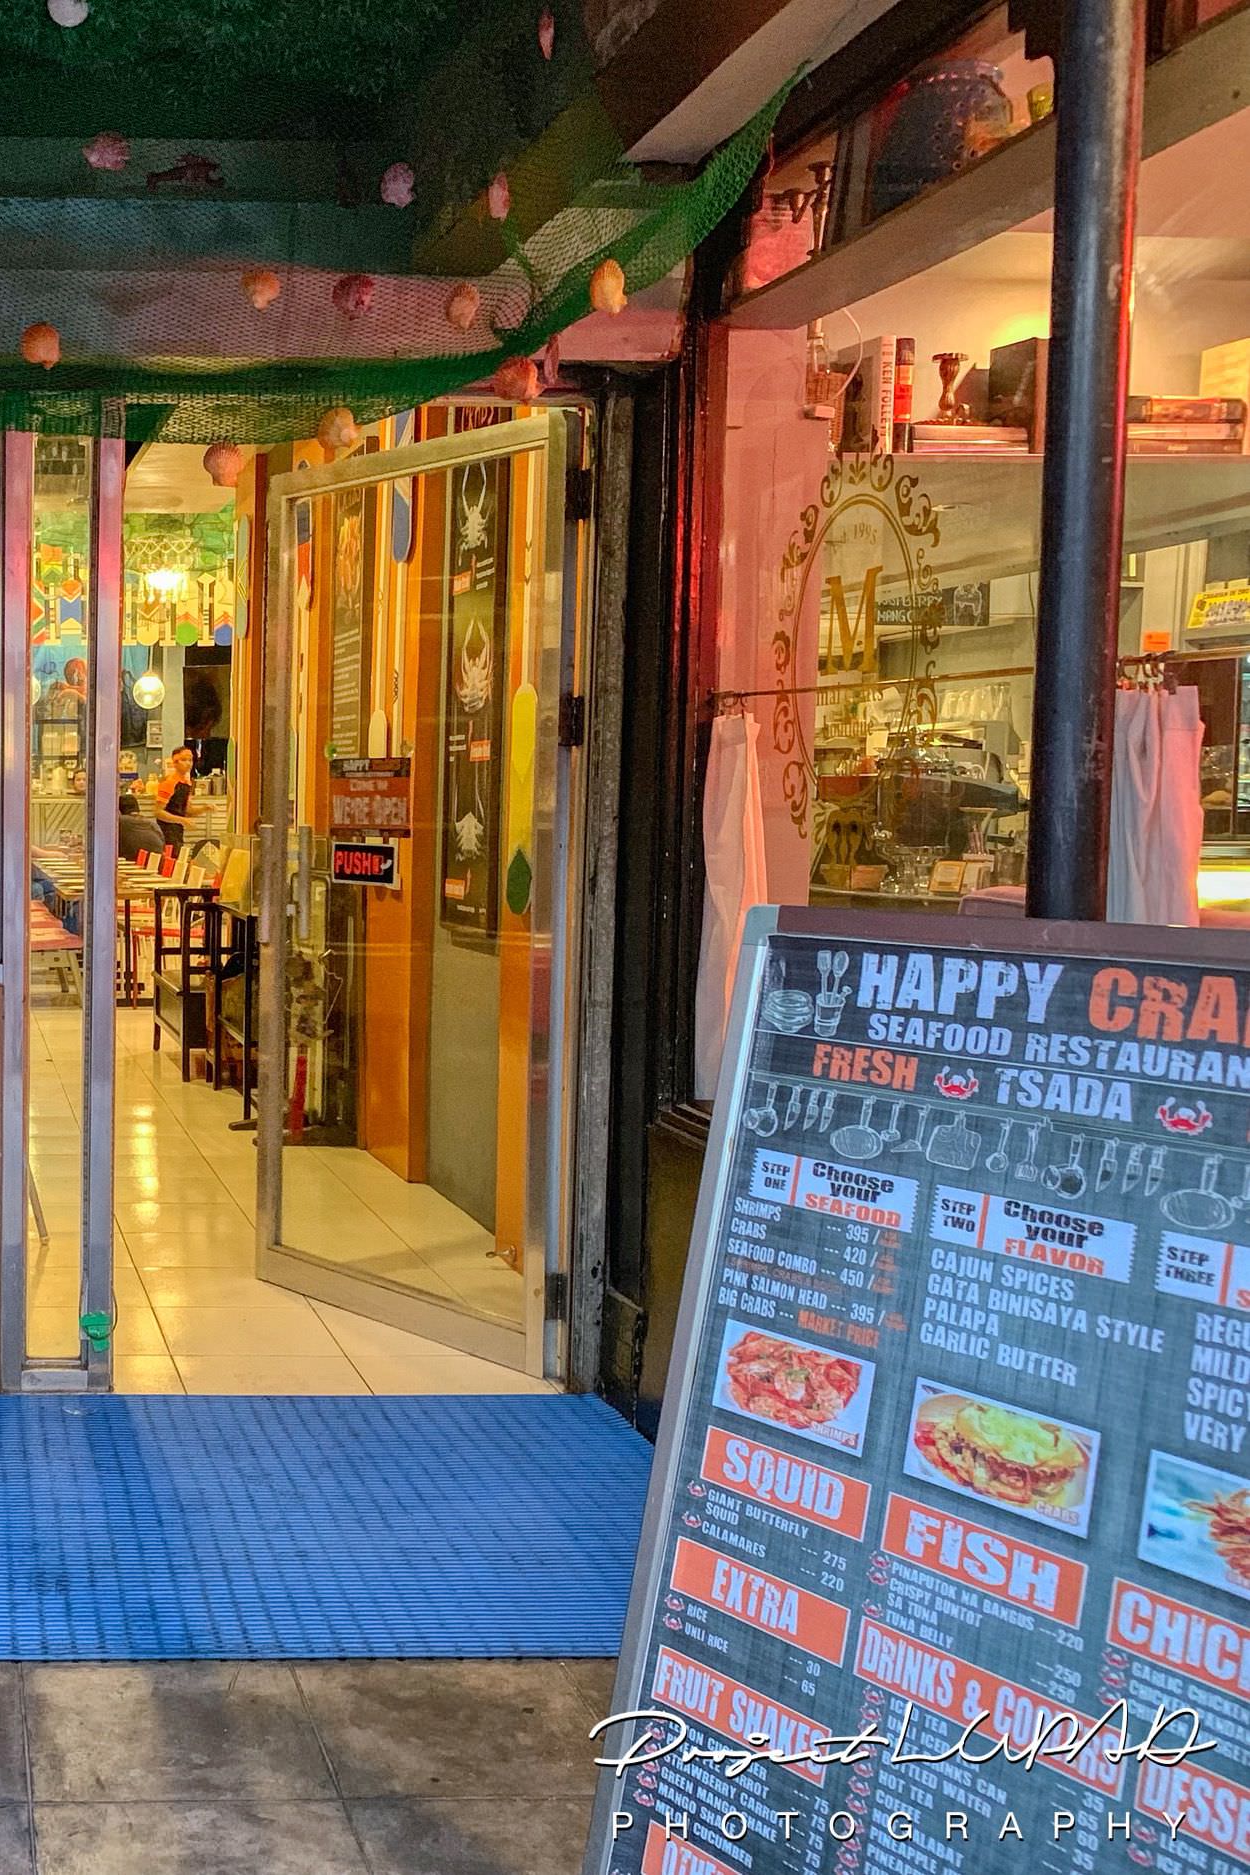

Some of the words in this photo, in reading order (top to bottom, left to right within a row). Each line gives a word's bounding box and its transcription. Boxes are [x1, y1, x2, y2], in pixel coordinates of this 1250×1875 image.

[821, 565, 883, 676] M
[334, 850, 372, 876] PUSH
[857, 952, 1064, 1024] HAPPY
[867, 1012, 1013, 1057] SEAFOOD
[812, 1043, 919, 1092] FRESH
[995, 1067, 1133, 1122] TSADA
[761, 1161, 791, 1177] STEP
[812, 1161, 895, 1194] Choose
[764, 1176, 787, 1191] ONE
[830, 1181, 881, 1203] your
[733, 1196, 782, 1222] SHRIMPS
[845, 1223, 869, 1245] 395
[805, 1193, 901, 1228] SEAFOOD
[940, 1198, 976, 1217] STEP
[1003, 1199, 1105, 1237] Choose
[942, 1214, 976, 1233] TWO
[1025, 1224, 1089, 1249] your
[727, 1237, 775, 1265] SEAFOOD
[776, 1250, 818, 1277] COMBO
[839, 1268, 864, 1288] 450
[730, 1216, 767, 1240] CRABS
[843, 1246, 867, 1266] 420
[1004, 1237, 1106, 1276] FLAVOR
[1166, 1246, 1210, 1268] STEP
[723, 1267, 748, 1289] PINK
[750, 1275, 796, 1304] SALMON
[797, 1289, 828, 1310] HEAD
[850, 1302, 875, 1324] 395
[930, 1248, 994, 1283] CAJUN
[1000, 1264, 1075, 1302] SPICES
[1164, 1263, 1216, 1288] THREE
[718, 1286, 739, 1308] BIG
[740, 1291, 776, 1318] CRABS
[923, 1296, 1000, 1337] PALAPA
[927, 1272, 980, 1305] GATA
[987, 1287, 1088, 1334] BINISAYA
[1095, 1315, 1166, 1354] STYLE
[919, 1321, 991, 1360] GARLIC
[996, 1342, 1078, 1388] BUTTER
[1187, 1376, 1250, 1423] SPIC
[1183, 1410, 1247, 1454] VERY
[721, 1438, 846, 1521] SQUID
[704, 1502, 740, 1526] SQUID
[822, 1549, 847, 1572] 275
[707, 1488, 743, 1512] GIANT
[745, 1503, 810, 1540] BUTTERFLY
[701, 1520, 767, 1559] CALAMARES
[819, 1571, 845, 1593] 220
[905, 1509, 1060, 1612] FISH
[711, 1558, 800, 1636] EXTRA
[886, 1592, 904, 1611] SA
[907, 1602, 938, 1626] TUNA
[889, 1577, 932, 1606] CRISPY
[686, 1603, 709, 1623] RICE
[805, 1660, 821, 1677] 30
[884, 1609, 916, 1633] TUNA
[918, 1624, 954, 1650] BELLY
[684, 1621, 706, 1642] UNLI
[707, 1633, 730, 1655] RICE
[801, 1679, 816, 1697] 65
[861, 1625, 957, 1708] DRINKS
[961, 1678, 984, 1721] &
[654, 1655, 726, 1721] FRUIT
[889, 1697, 919, 1723] ICD
[923, 1712, 948, 1736] TEA
[657, 1781, 697, 1814] MANGO
[663, 1750, 737, 1799] STRAWBERRY
[807, 1831, 824, 1851] 75
[813, 1795, 830, 1816] 75
[878, 1769, 906, 1794] HOT
[909, 1786, 934, 1810] TEA
[660, 1766, 694, 1794] GREEN
[805, 1849, 821, 1869] 75
[810, 1813, 826, 1833] 75
[692, 1822, 754, 1869] CUCUMBER
